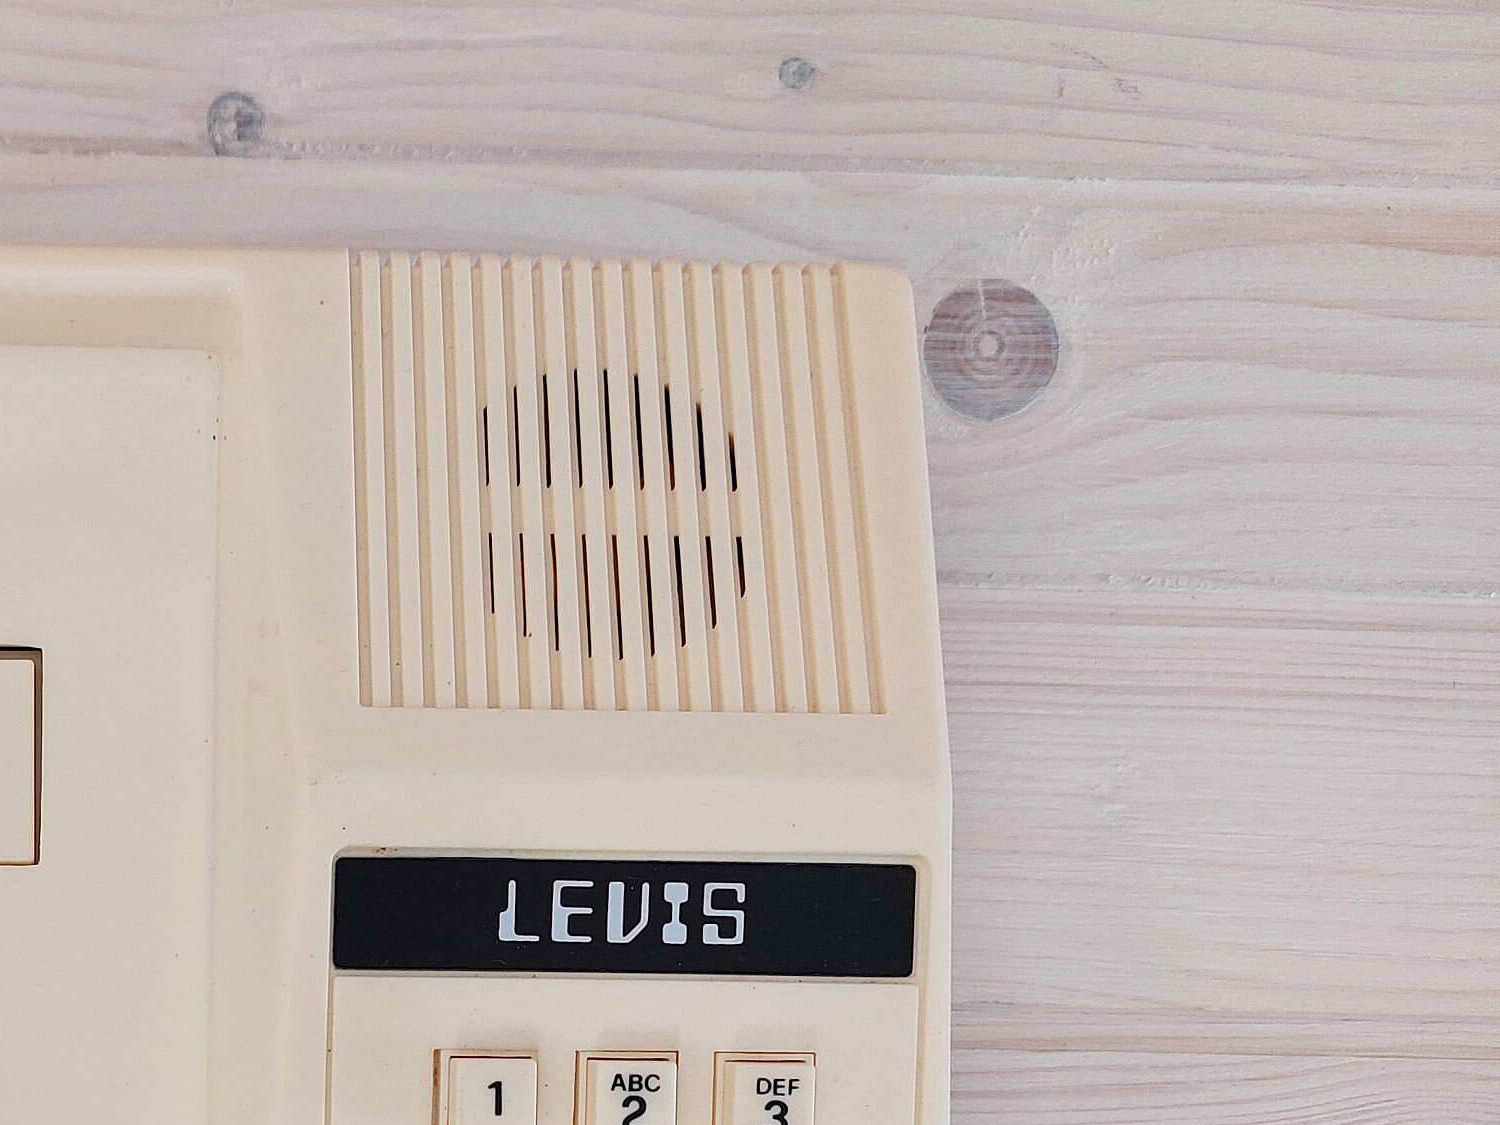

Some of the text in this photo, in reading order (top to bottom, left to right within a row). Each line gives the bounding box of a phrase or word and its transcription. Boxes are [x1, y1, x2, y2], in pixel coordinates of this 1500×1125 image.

[498, 879, 746, 945] LEVIS
[610, 1073, 661, 1093] ABC
[756, 1077, 800, 1097] DEF
[487, 1080, 503, 1117] 1
